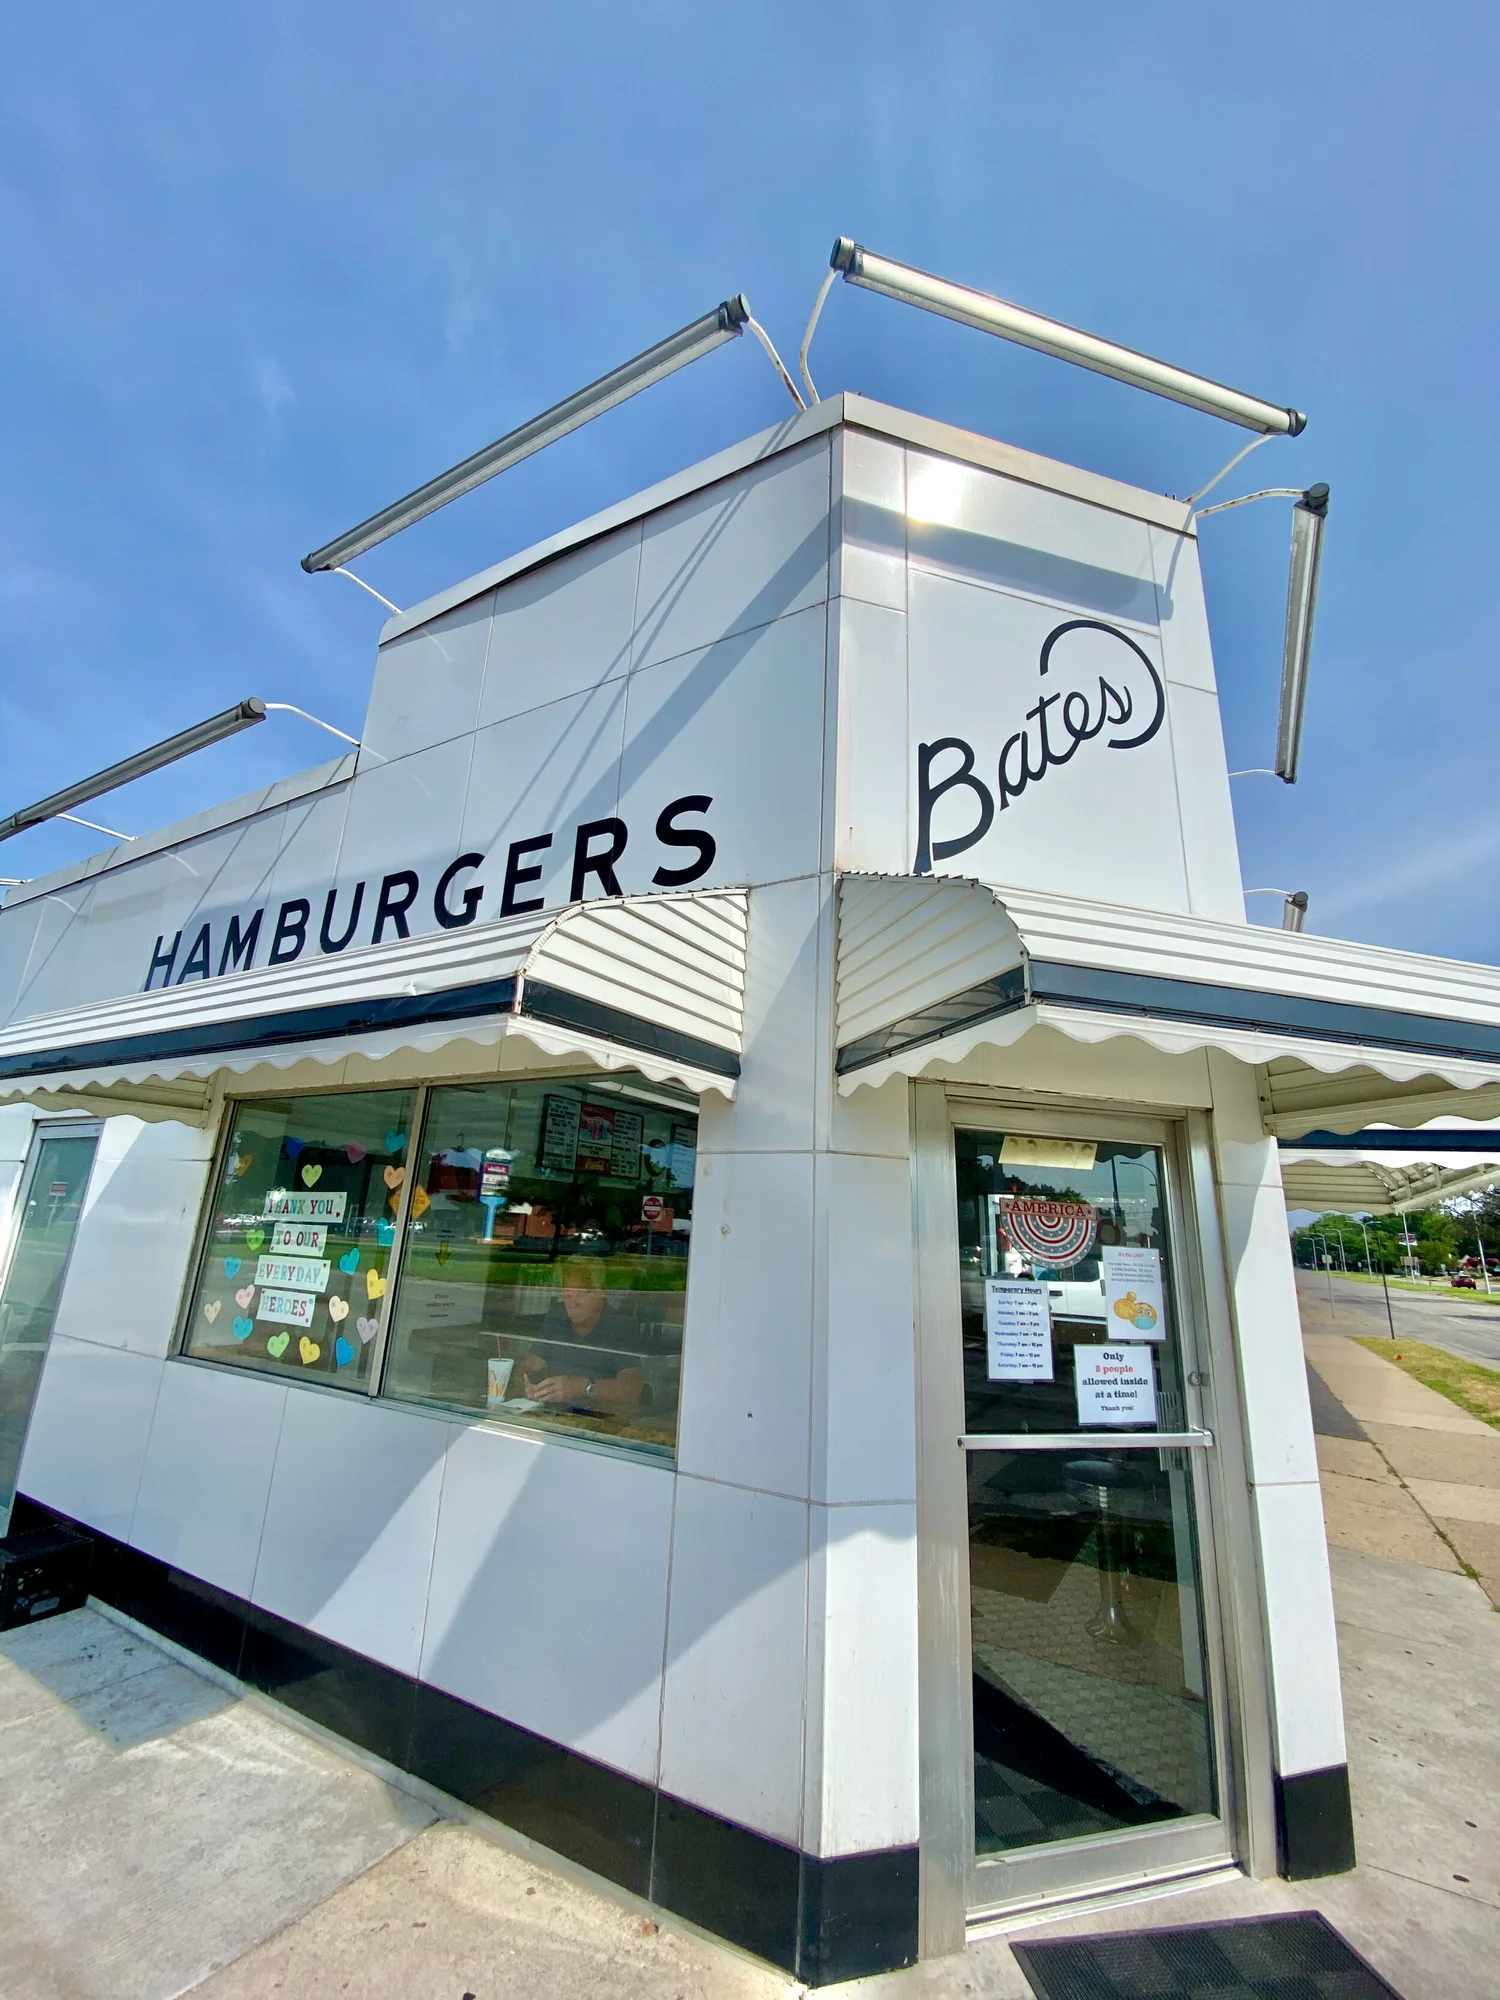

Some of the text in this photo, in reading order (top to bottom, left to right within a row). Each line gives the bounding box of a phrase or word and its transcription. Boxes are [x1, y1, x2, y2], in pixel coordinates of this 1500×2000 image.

[911, 672, 1134, 875] Bates
[144, 794, 718, 993] HAMBURGERS
[268, 1199, 334, 1214] THANK YOU
[1012, 1201, 1086, 1217] AMERICA
[276, 1230, 319, 1248] TO OUR
[258, 1264, 320, 1284] EVERYDAY
[991, 1286, 1023, 1294] Temporary
[261, 1296, 306, 1317] HEROES
[1103, 1352, 1124, 1362] Only
[1103, 1365, 1133, 1374] people
